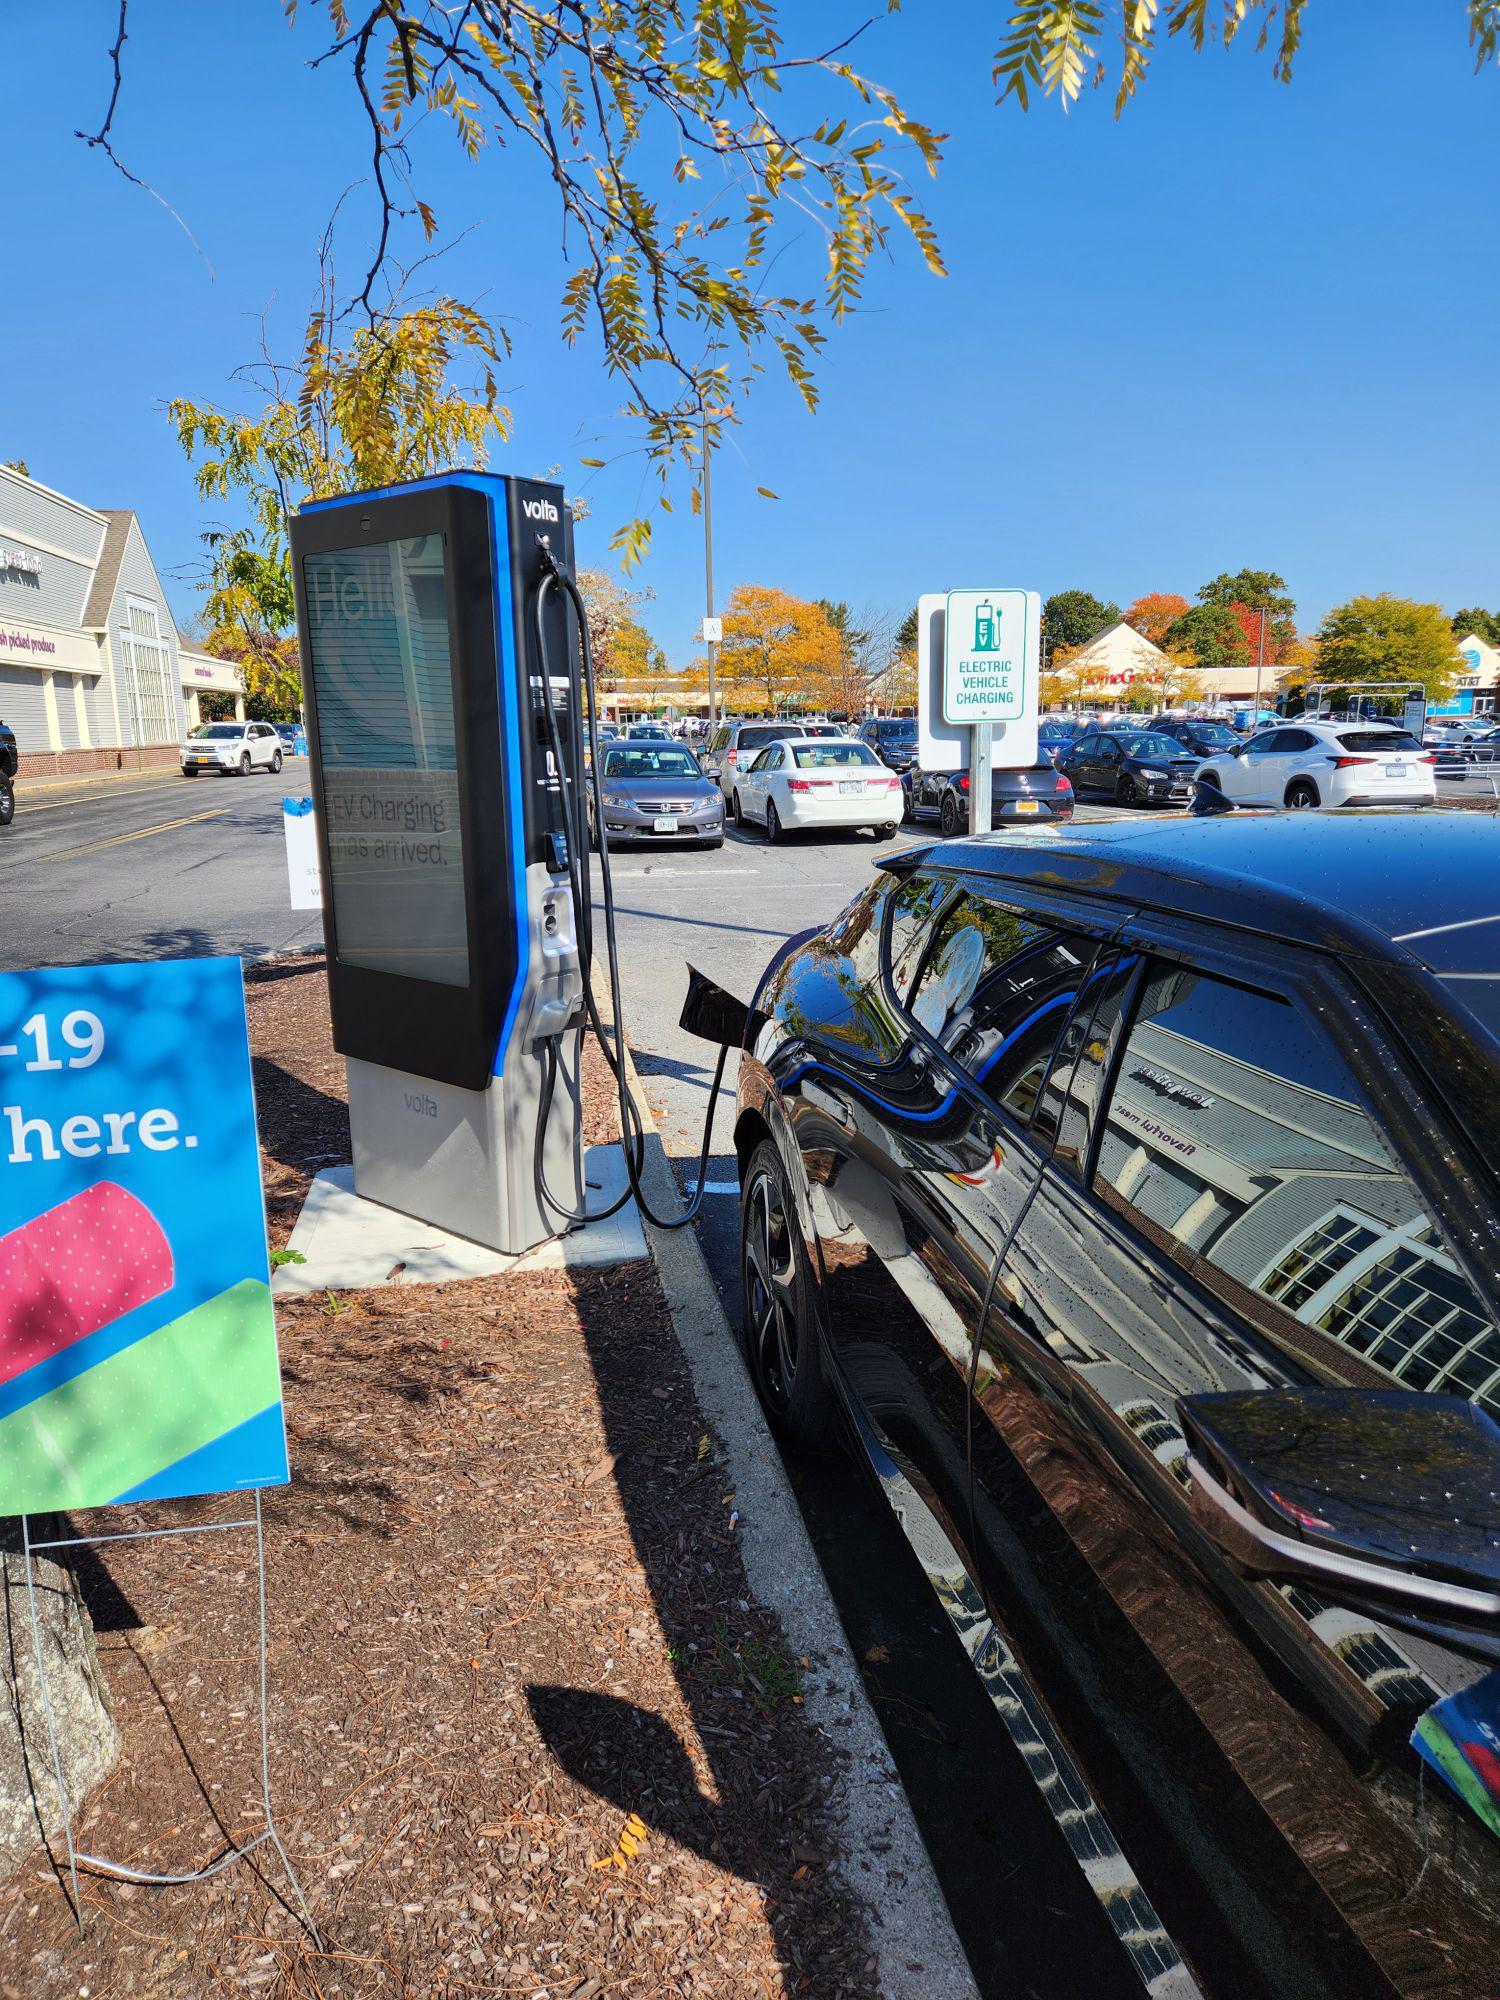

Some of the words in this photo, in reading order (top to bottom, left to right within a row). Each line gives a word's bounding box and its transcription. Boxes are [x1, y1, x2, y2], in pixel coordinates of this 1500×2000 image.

[522, 499, 559, 522] volta
[8, 631, 30, 651] picked
[30, 636, 56, 654] produce
[959, 660, 1012, 673] ELECTRIC
[1086, 667, 1165, 686] omeGds
[963, 676, 1009, 689] VEHICLE
[1455, 676, 1481, 687] AT&T
[956, 691, 1014, 705] CHARGING
[333, 795, 354, 820] EV
[360, 793, 446, 833] Charging
[337, 834, 369, 857] has
[374, 835, 448, 866] arrived.
[404, 1092, 438, 1118] volta
[3, 1106, 198, 1163] here.
